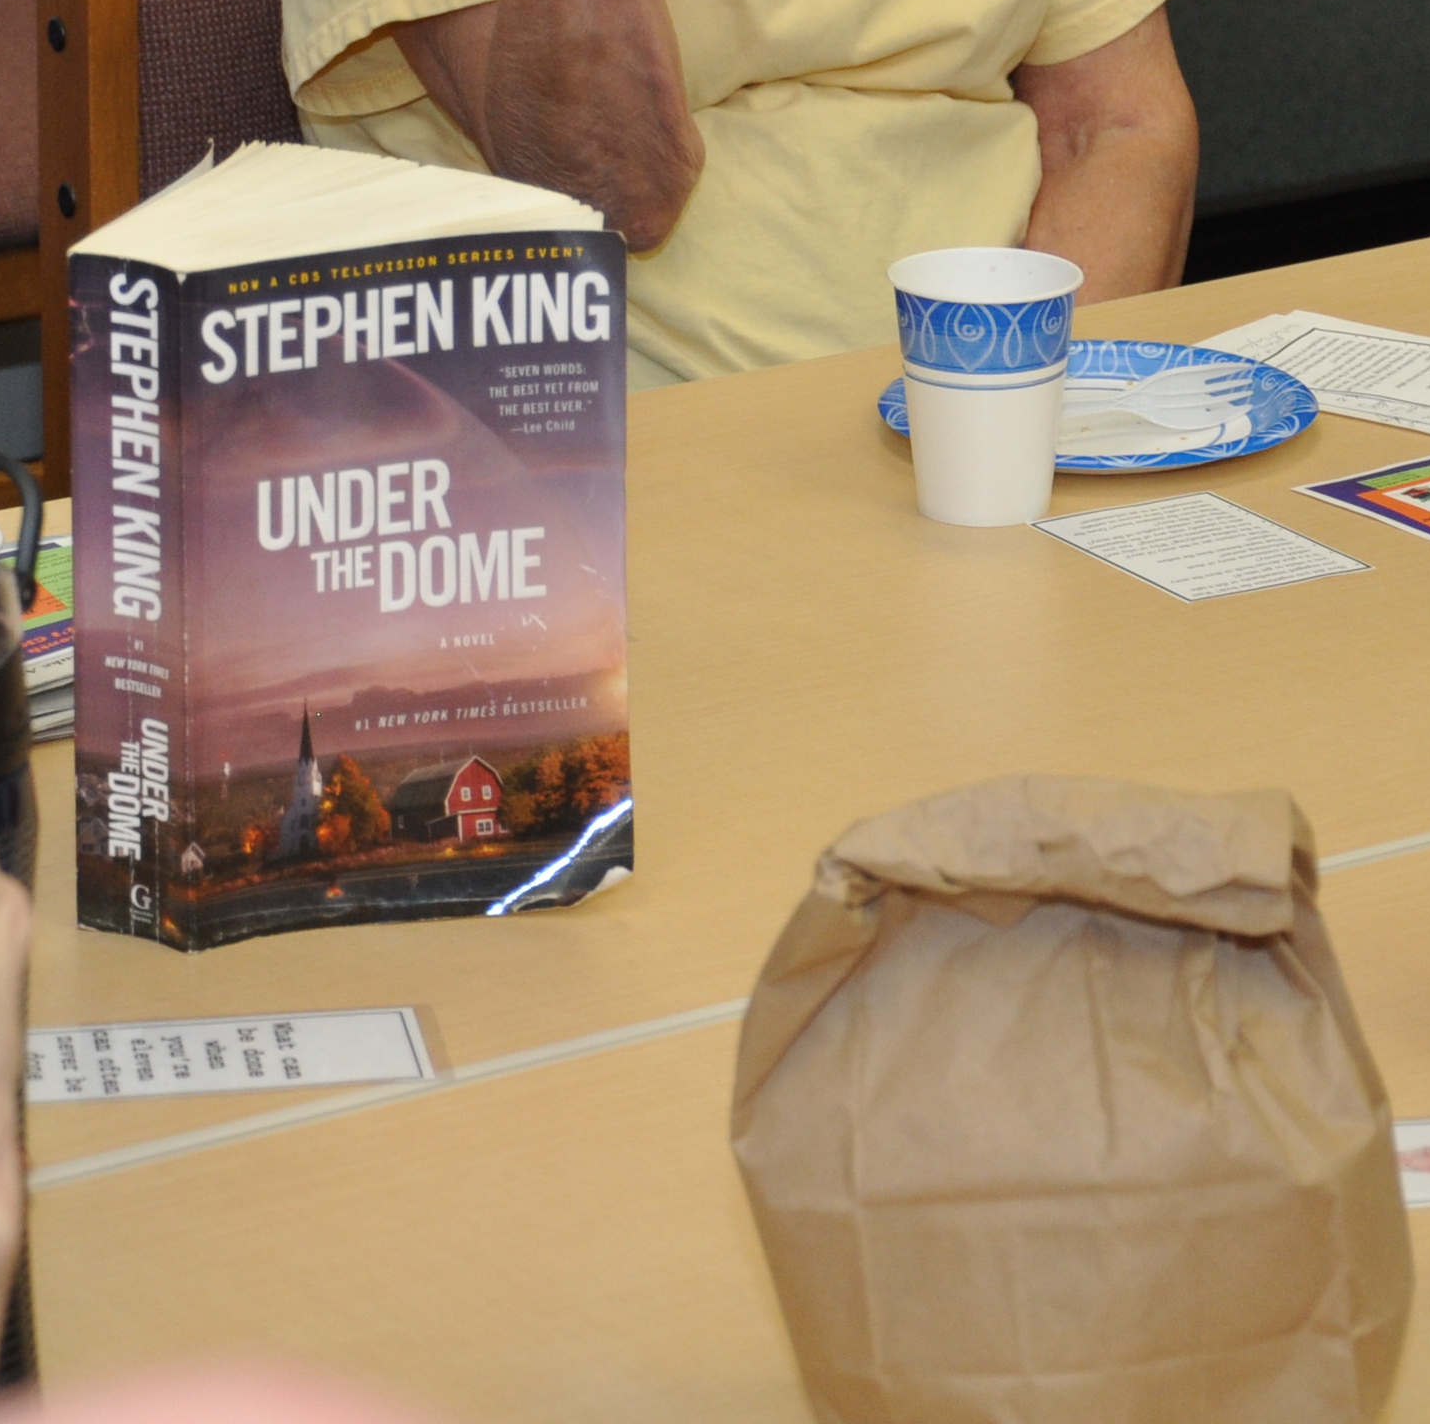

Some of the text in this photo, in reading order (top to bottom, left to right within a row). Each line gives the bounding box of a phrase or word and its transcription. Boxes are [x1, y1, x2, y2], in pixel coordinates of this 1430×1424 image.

[228, 245, 585, 295] NOW A CBS TELEVISION SERIES EVENT
[200, 271, 612, 385] STEPHEN KING
[488, 379, 600, 399] THE BEST YET FROM
[544, 362, 586, 377] WORDS:
[498, 402, 519, 417] THE
[522, 401, 551, 415] BEST
[545, 418, 576, 432] Child
[109, 272, 163, 623] STEPHEN KING
[257, 458, 452, 552] UNDER
[309, 525, 548, 614] THE DOME
[440, 632, 496, 650] A NOVEL
[105, 656, 170, 680] NEW YORK TIMES
[115, 677, 161, 698] BESTSELLER
[354, 697, 589, 733] #1 NEW YORK TIMES BESTSELLER
[140, 717, 170, 824] UNDER
[107, 740, 141, 862] THE DOME
[130, 884, 152, 910] G
[57, 1037, 86, 1092] never be
[93, 1029, 121, 1094] can often
[131, 1039, 154, 1081] eleven
[160, 1035, 190, 1078] you're
[206, 1040, 226, 1070] when
[237, 1027, 265, 1077] be done
[273, 1021, 302, 1079] What can
